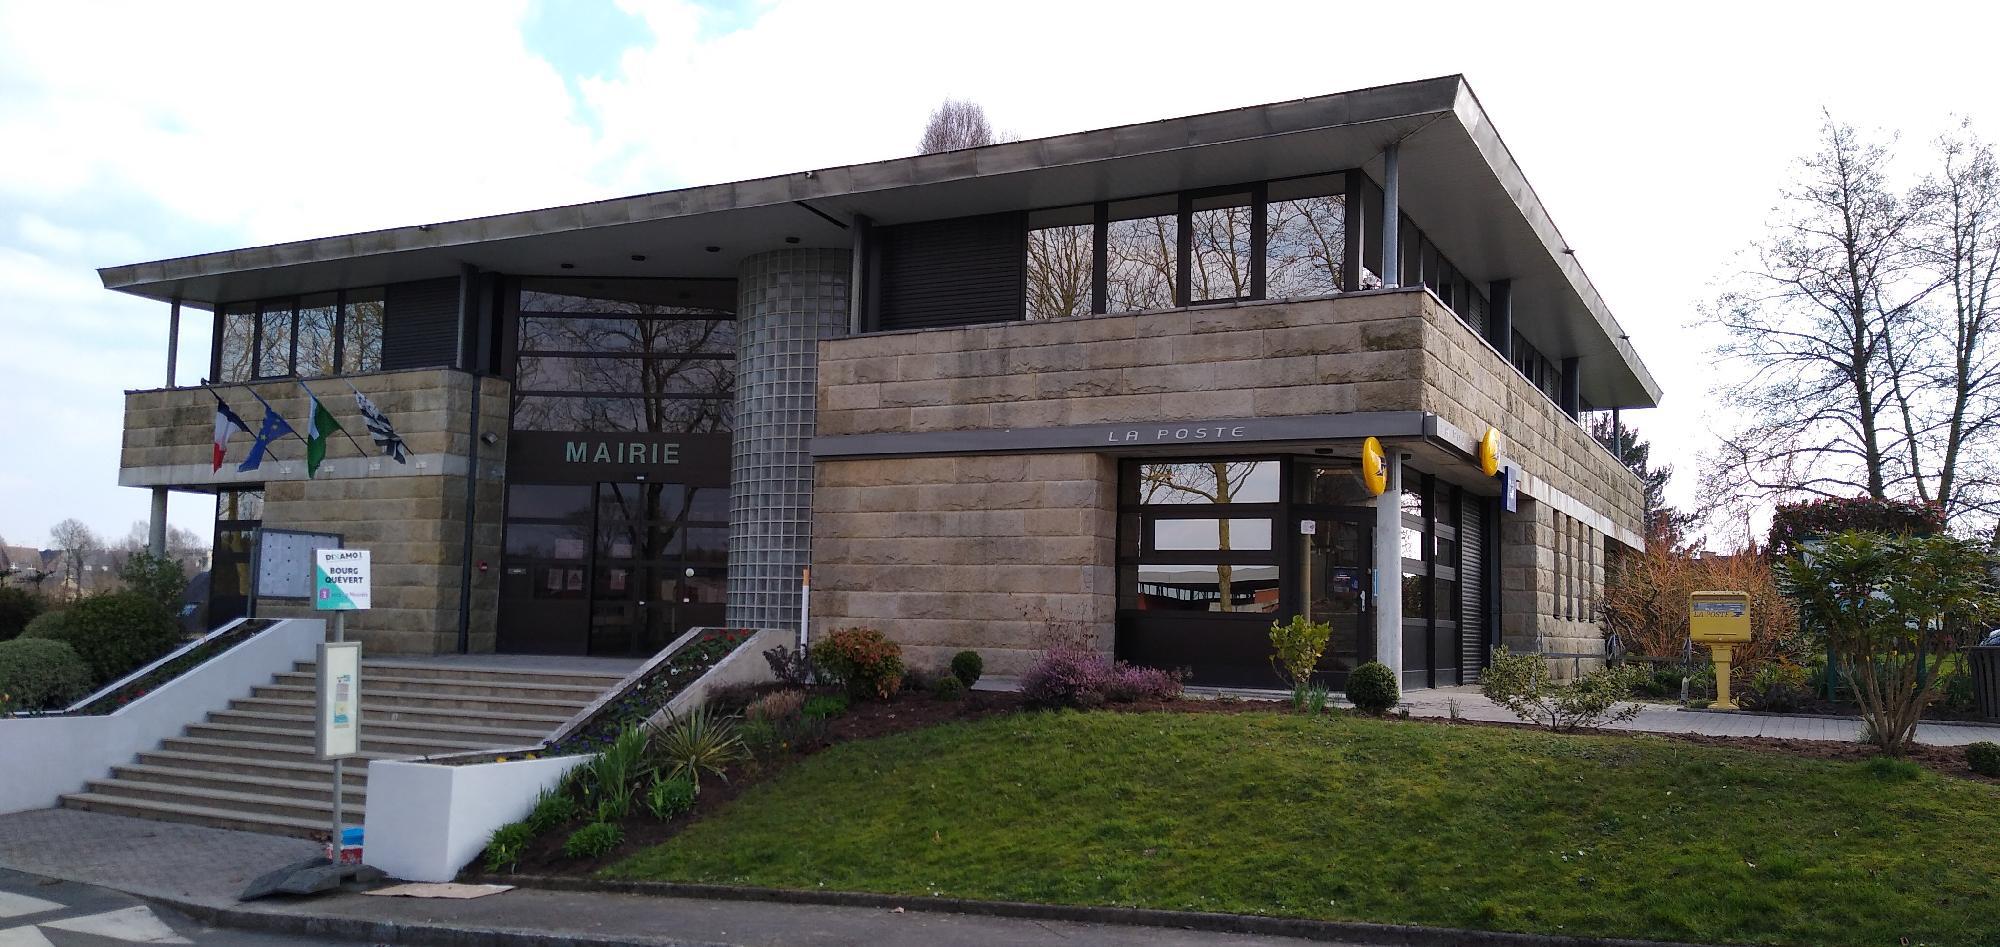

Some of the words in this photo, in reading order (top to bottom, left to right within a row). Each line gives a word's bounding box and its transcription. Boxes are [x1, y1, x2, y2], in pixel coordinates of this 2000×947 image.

[1108, 430, 1139, 442] LA
[1157, 426, 1246, 440] POSTE
[565, 441, 680, 464] MAIRIE
[330, 567, 359, 575] BOURG
